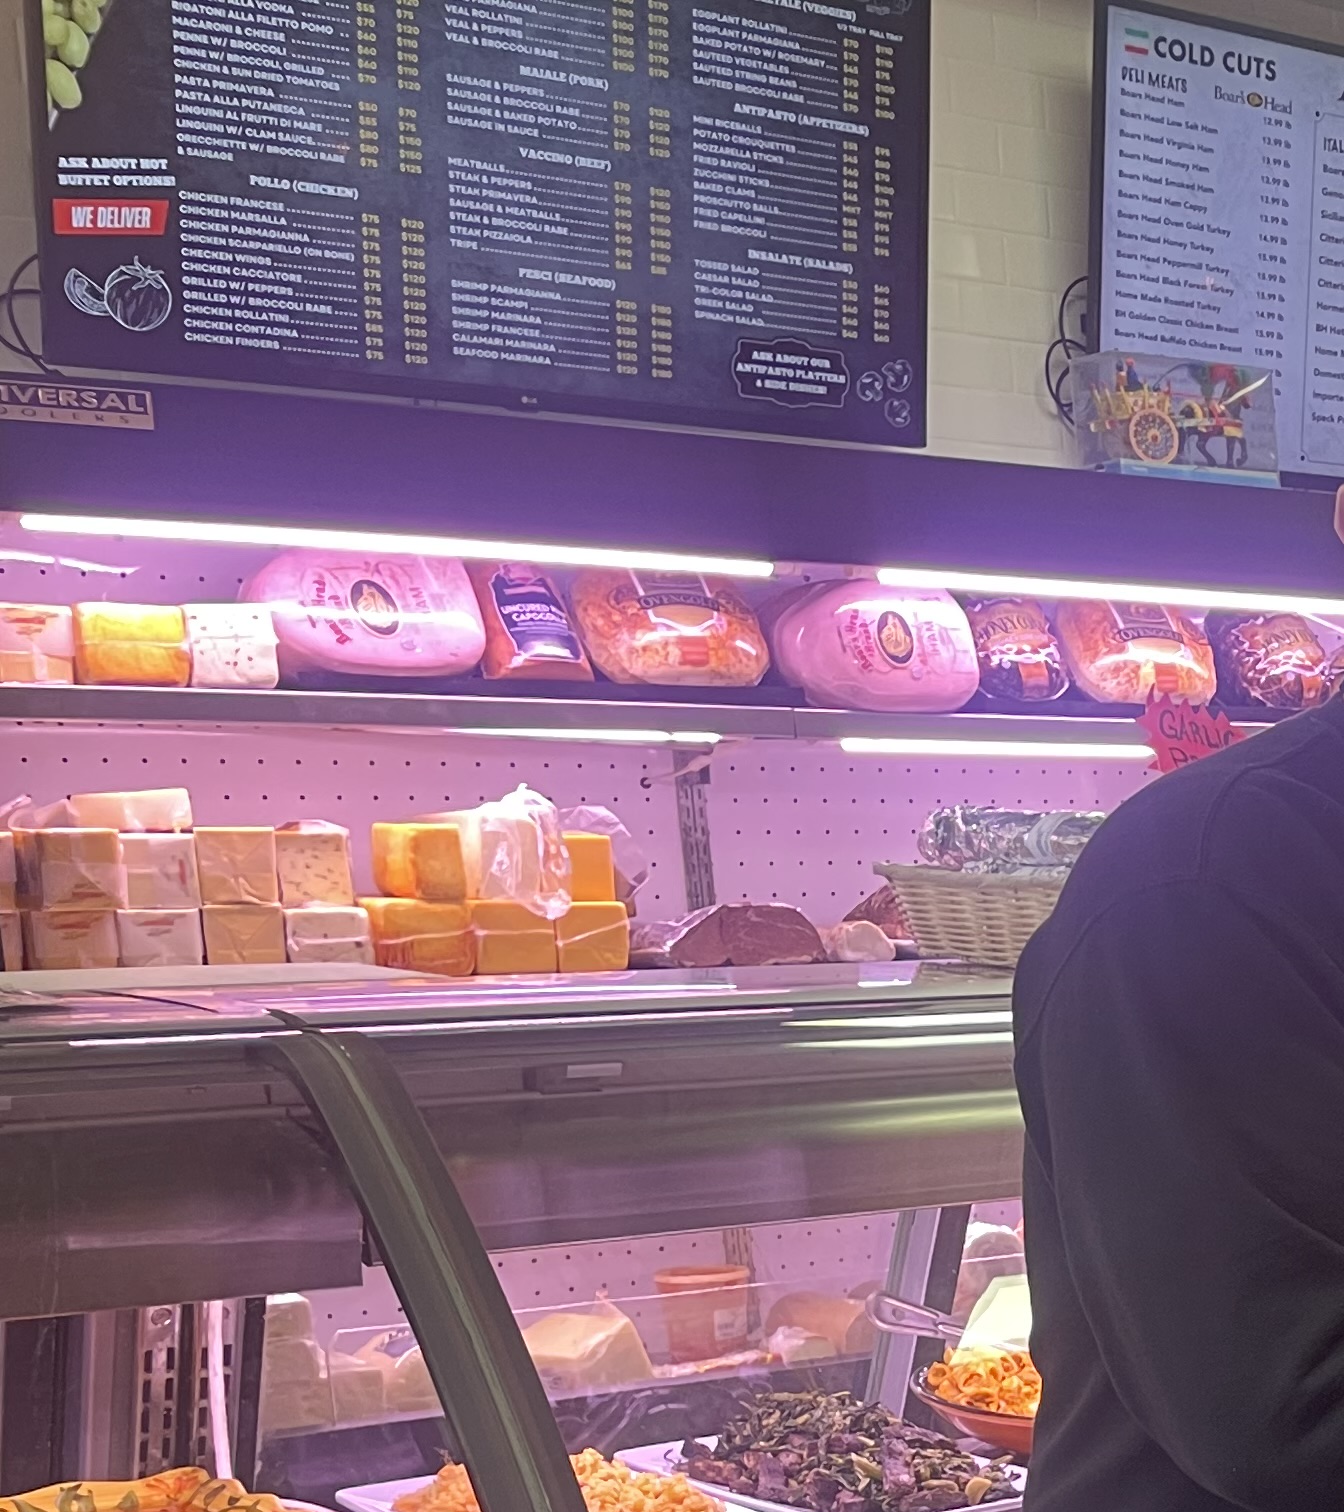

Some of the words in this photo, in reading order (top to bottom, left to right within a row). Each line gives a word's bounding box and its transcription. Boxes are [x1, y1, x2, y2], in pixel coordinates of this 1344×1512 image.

[172, 16, 233, 34] MACARONI
[244, 28, 285, 42] CHEESE
[301, 19, 334, 35] POMO
[173, 30, 209, 44] PENNE
[230, 39, 287, 56] BROCCOLI
[1154, 36, 1214, 67] COLD
[1222, 51, 1277, 82] CUTS
[175, 74, 210, 87] PASTA
[212, 79, 275, 97] PRIMAVERA
[1121, 66, 1144, 84] DELI
[1149, 72, 1187, 93] MEATS
[503, 83, 544, 98] PEPPERS
[1264, 96, 1292, 115] Head
[58, 157, 88, 169] ASK
[91, 157, 137, 170] ABOUT
[140, 159, 168, 170] HOT
[250, 174, 290, 190] POLLO
[71, 206, 94, 228] WE
[97, 207, 151, 229] DELIVER
[179, 190, 228, 205] CHICKEN
[230, 196, 285, 211] FRANCESE
[401, 218, 424, 230] $120
[179, 205, 228, 219] CHICKEN
[231, 210, 287, 226] MARSALLA
[180, 219, 229, 233] CHICKEN
[450, 239, 478, 250] TRIPE
[181, 262, 230, 276] CHICKEN
[248, 283, 293, 296] PEPPERS
[0, 385, 144, 412] IVERSAL
